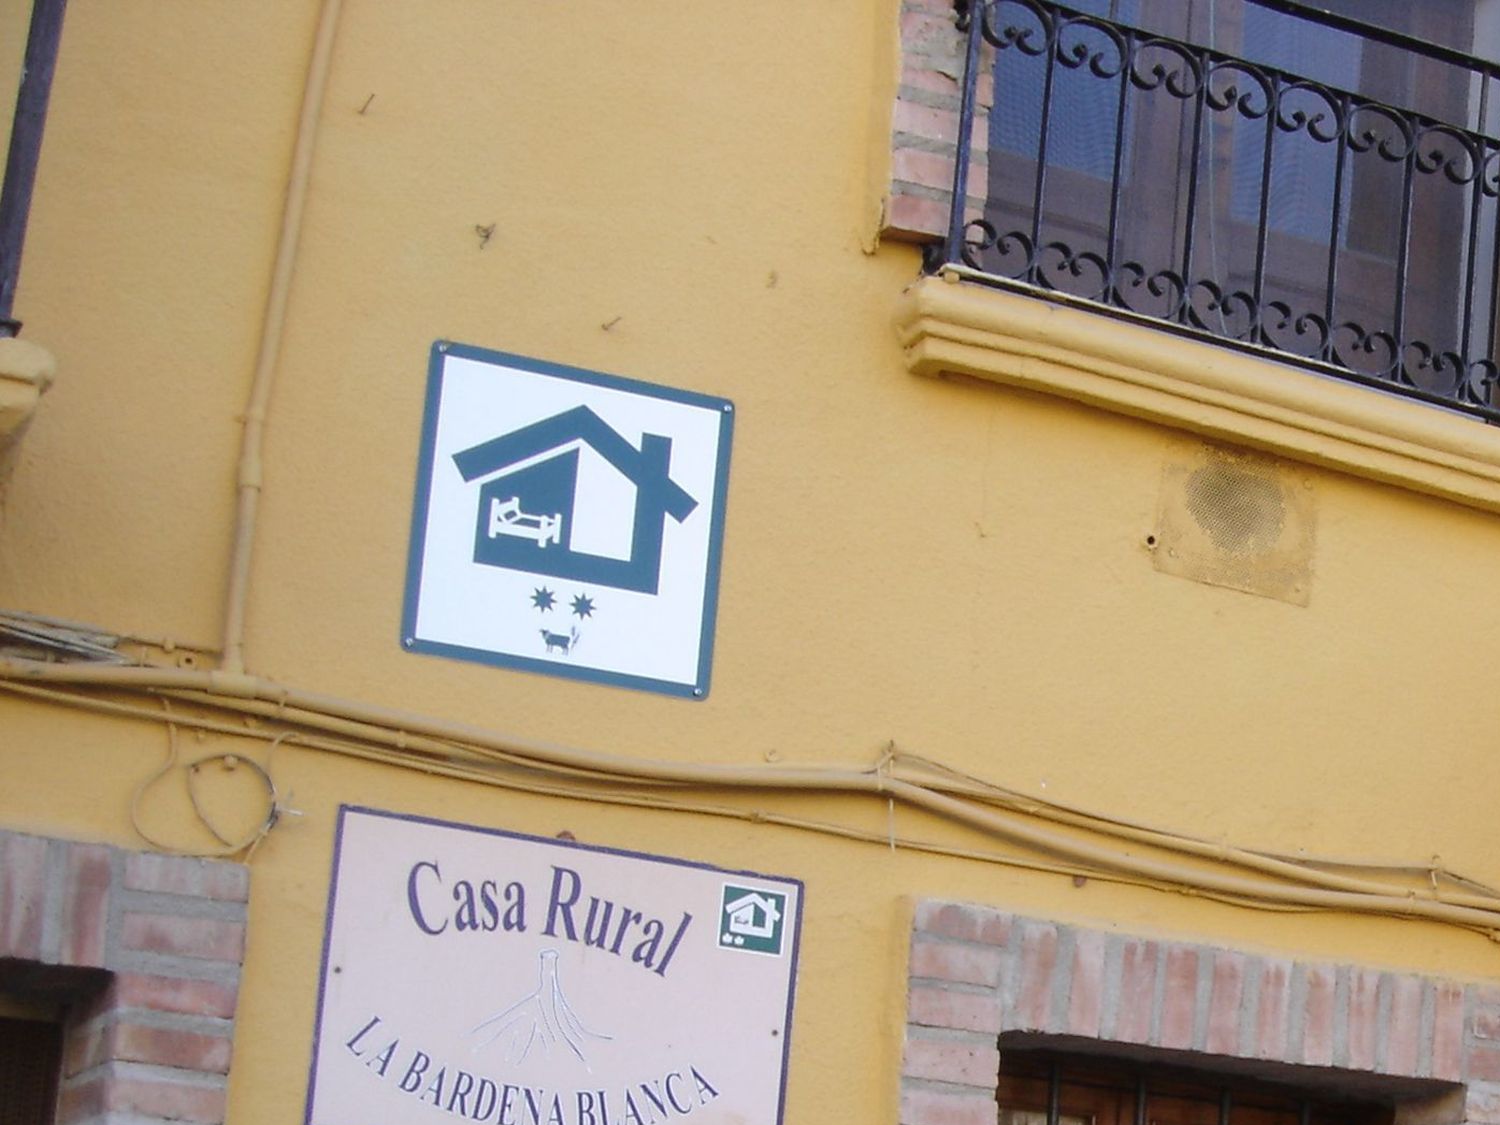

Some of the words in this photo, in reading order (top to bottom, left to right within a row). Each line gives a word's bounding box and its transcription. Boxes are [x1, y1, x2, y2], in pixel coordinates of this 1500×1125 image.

[406, 861, 527, 936] Casa
[541, 865, 693, 977] Rural
[346, 1016, 399, 1076] LA
